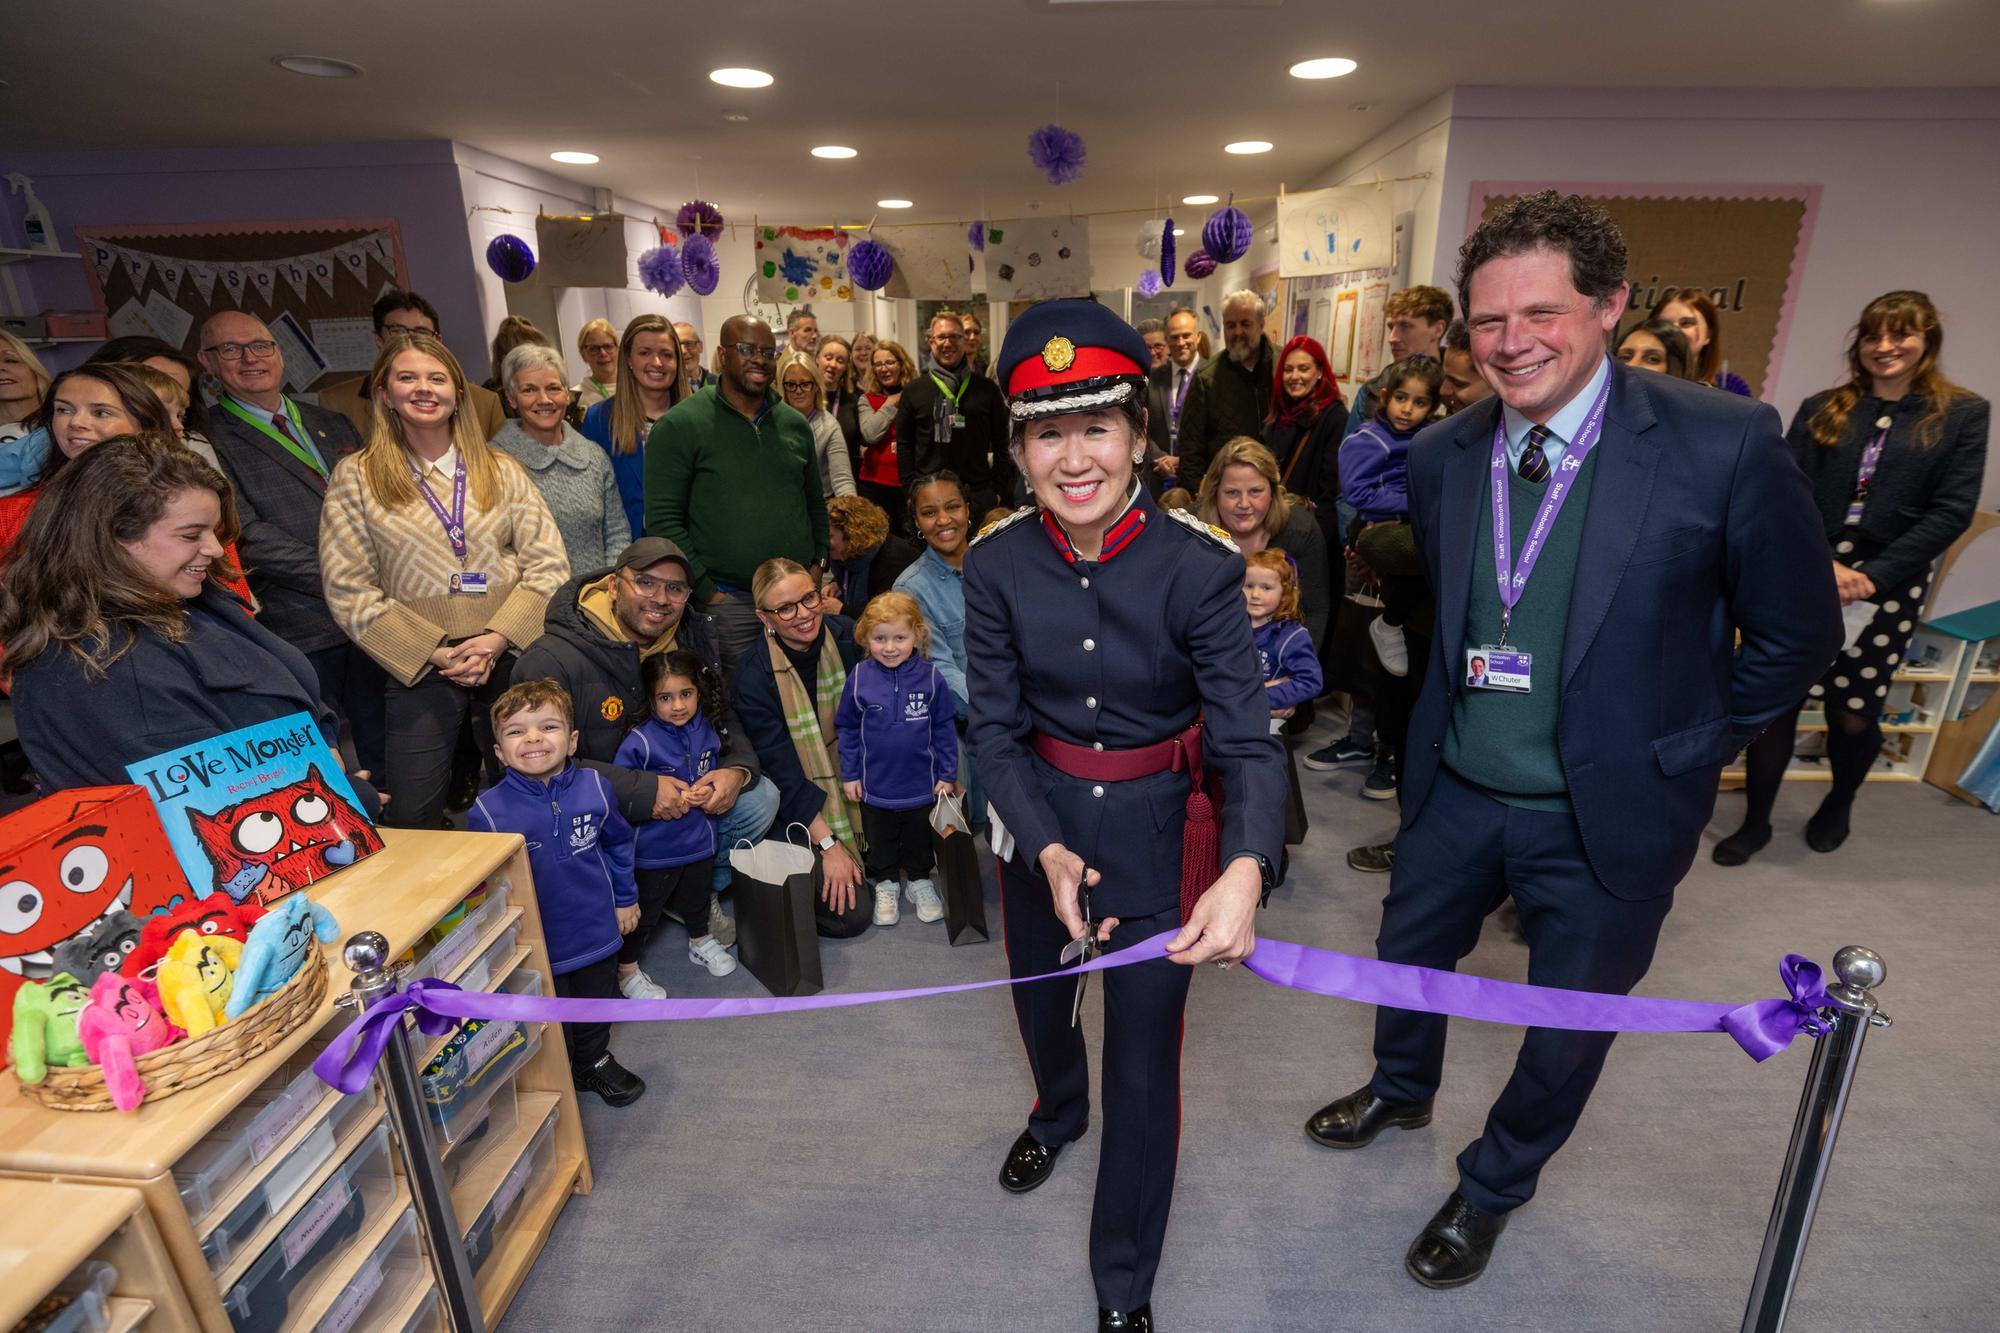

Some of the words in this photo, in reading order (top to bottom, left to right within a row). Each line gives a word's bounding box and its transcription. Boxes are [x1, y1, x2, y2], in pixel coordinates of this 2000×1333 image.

[1578, 420, 1596, 446] School
[1551, 482, 1564, 499] Staff
[1534, 503, 1554, 540] Kimbolton
[1523, 539, 1538, 564] School
[224, 724, 317, 774] Monster
